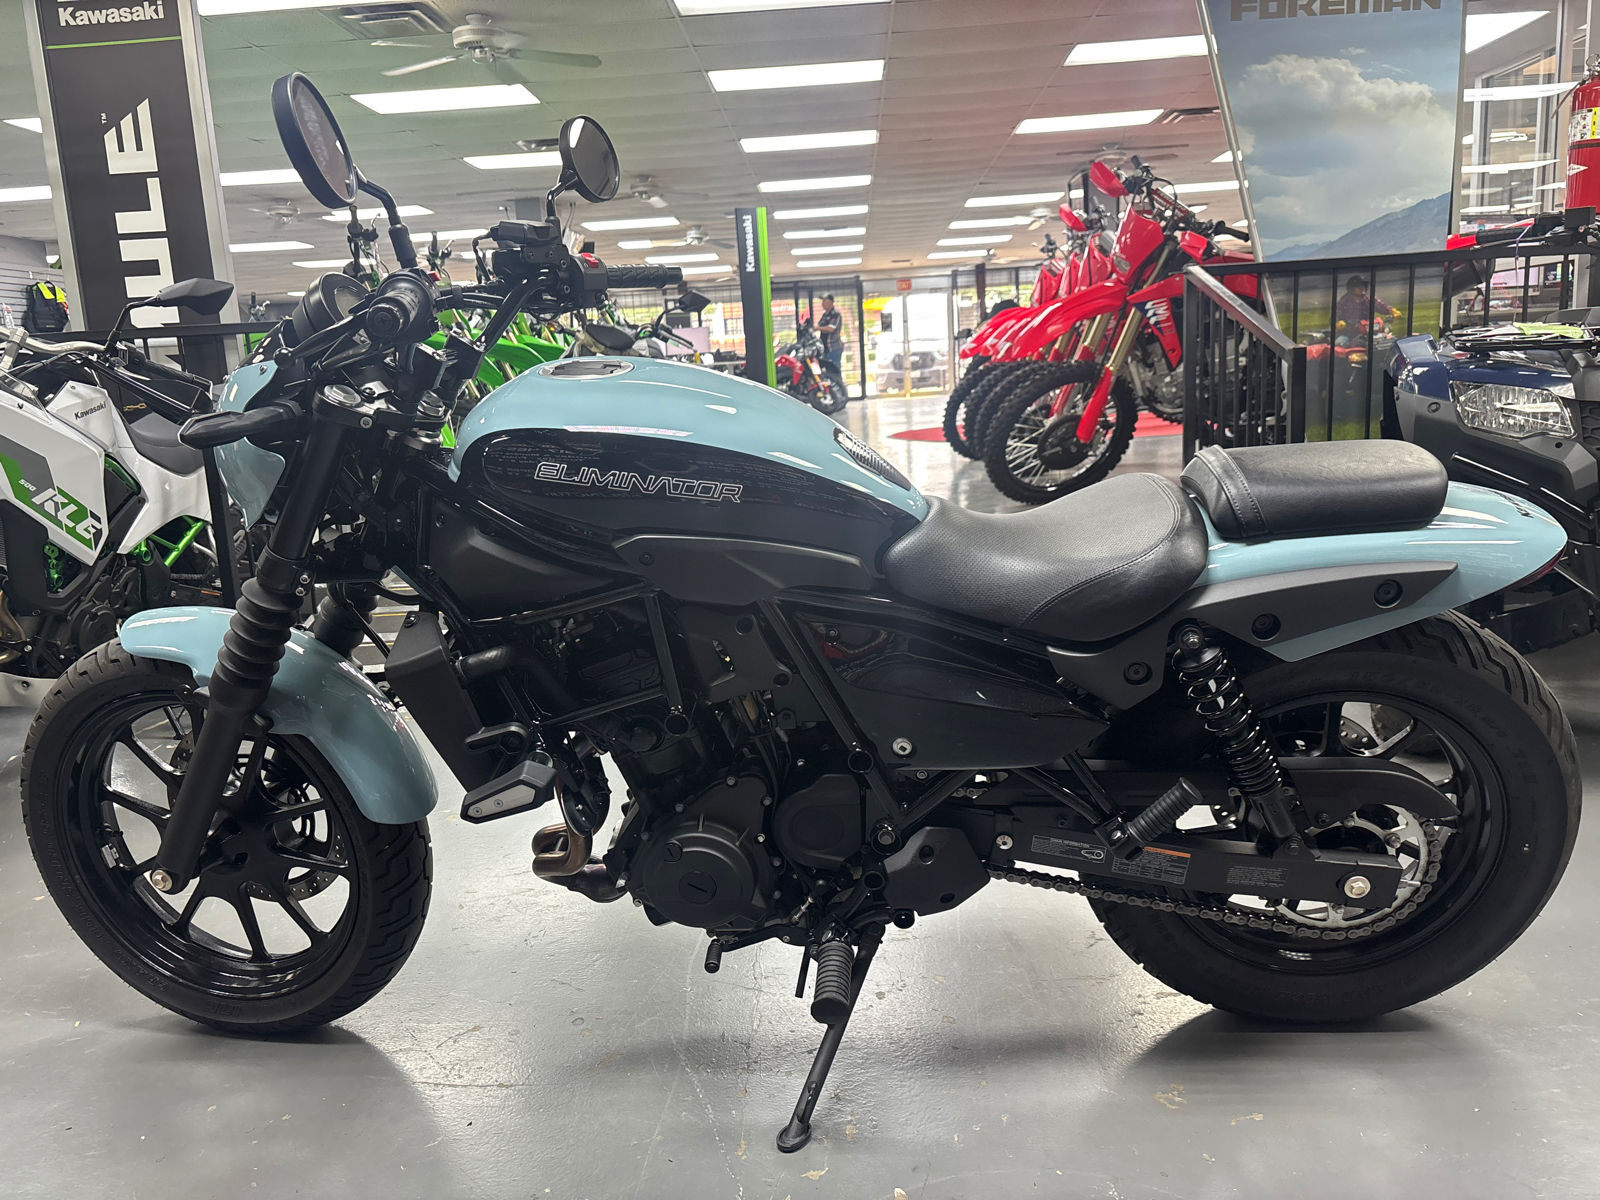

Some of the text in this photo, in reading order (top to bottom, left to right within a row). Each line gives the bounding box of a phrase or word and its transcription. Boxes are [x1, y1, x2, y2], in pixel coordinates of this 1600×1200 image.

[58, 1, 164, 26] Kawasaki
[745, 214, 755, 272] Kawasaki
[74, 401, 107, 420] Kawasaki
[18, 478, 37, 492] 500
[534, 461, 743, 503] ELIMINATOR
